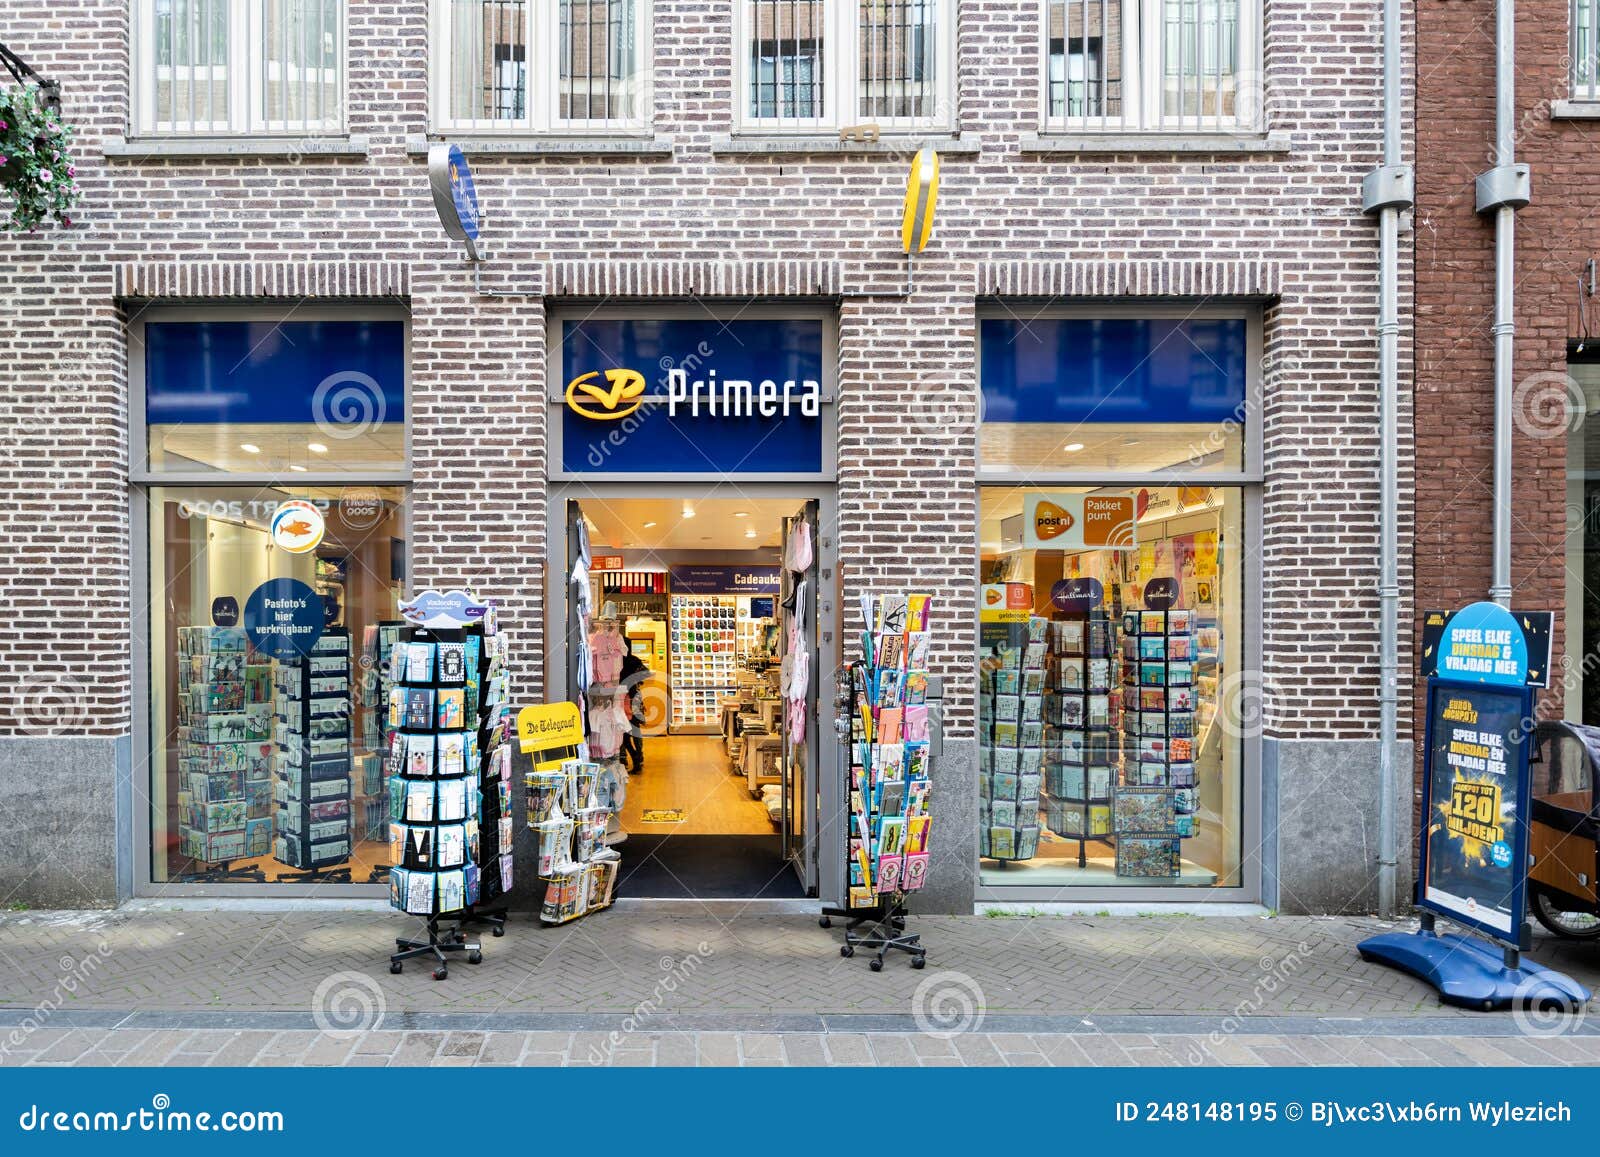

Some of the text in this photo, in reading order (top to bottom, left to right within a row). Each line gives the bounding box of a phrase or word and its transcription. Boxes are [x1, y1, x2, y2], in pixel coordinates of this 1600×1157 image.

[668, 369, 820, 417] Primera
[1087, 500, 1122, 511] Pakket
[1037, 516, 1071, 527] postnl
[1087, 511, 1112, 523] punt
[264, 598, 306, 609] Pasfoto's
[1057, 589, 1098, 604] Hallmark
[274, 612, 294, 622] hier
[255, 624, 313, 636] verkrijgbaar
[1451, 628, 1512, 644] SPEEL ELKE
[1451, 643, 1512, 660] DINSDAG &
[1445, 656, 1518, 675] VRIJDAG MEE
[527, 715, 576, 735] De Telegraaf
[1452, 728, 1502, 747] SPEEL ELKE
[1450, 740, 1489, 759] DINSDAG
[1447, 752, 1507, 775] VRIJDAG MEE
[1452, 792, 1493, 824] 120
[1448, 816, 1497, 843] MILJOEN
